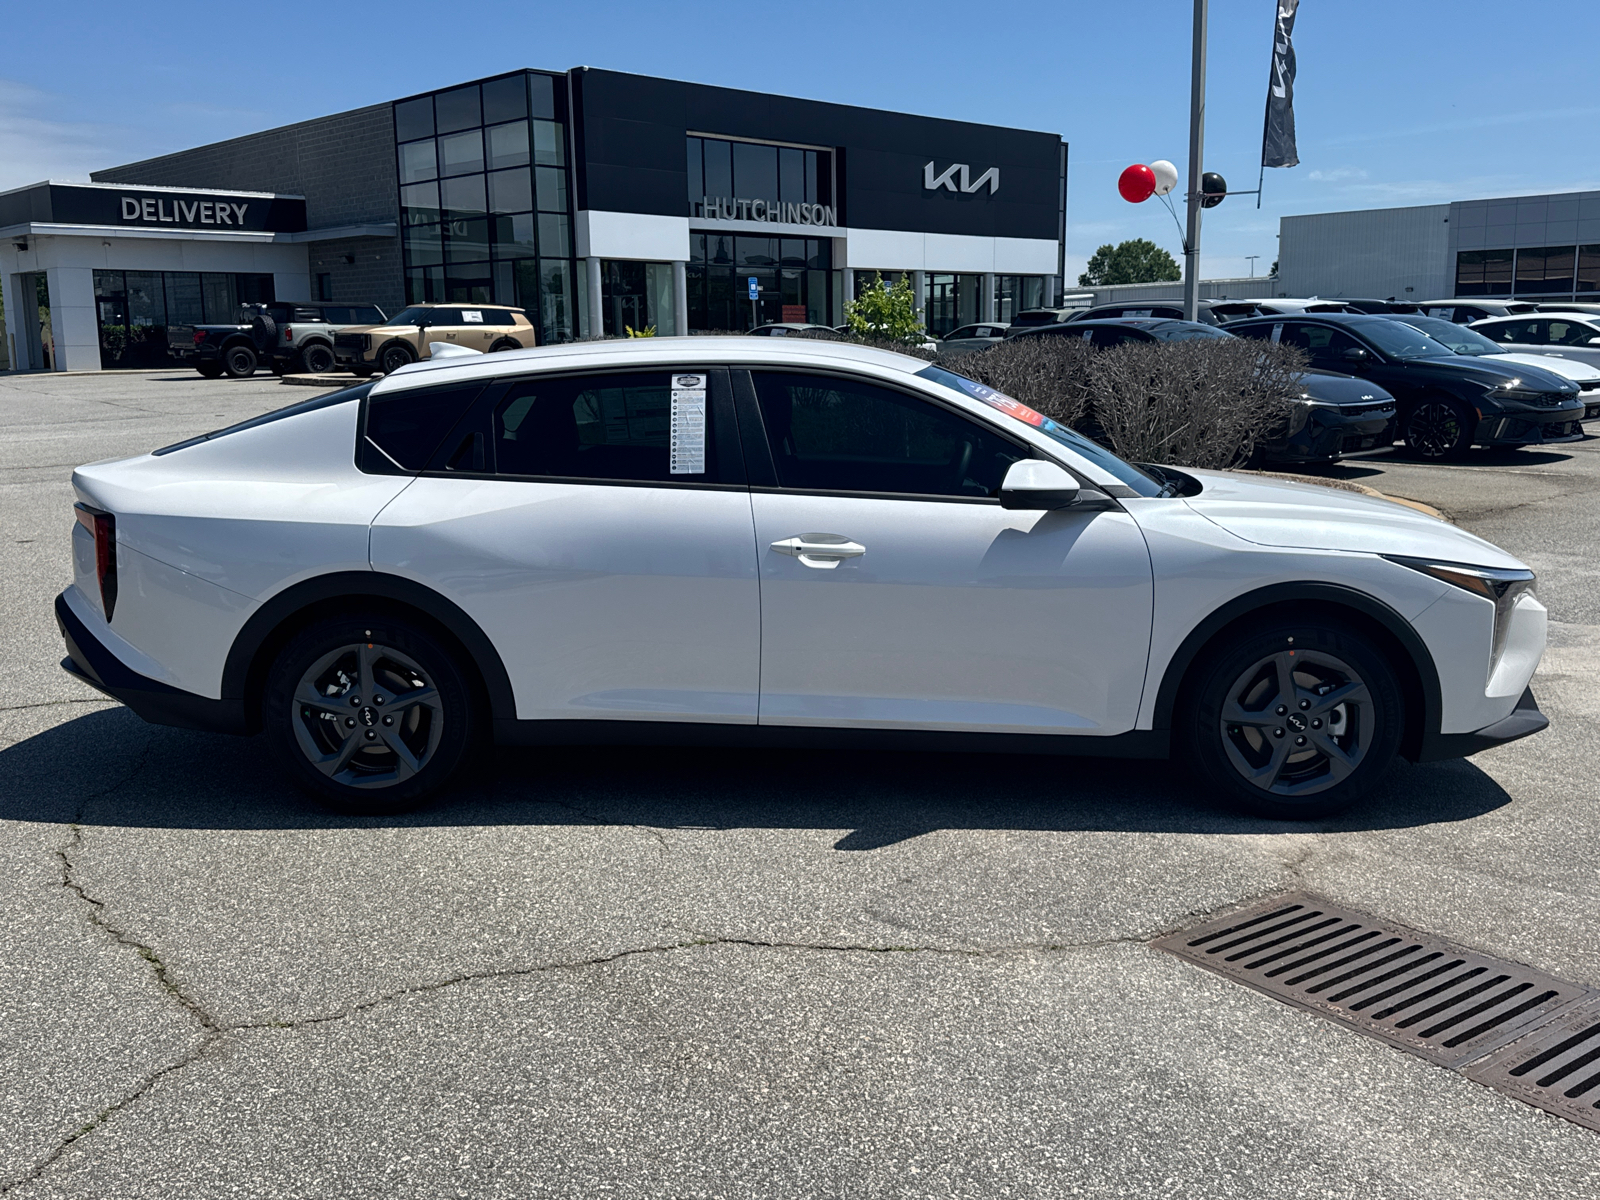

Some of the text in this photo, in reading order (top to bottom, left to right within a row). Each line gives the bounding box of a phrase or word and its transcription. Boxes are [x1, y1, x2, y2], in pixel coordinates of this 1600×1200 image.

[924, 160, 1000, 196] KIA
[121, 196, 249, 225] DELIVERY
[703, 195, 838, 228] HUTCHINSON
[364, 707, 373, 726] KIA
[444, 681, 460, 741] KUMHO
[1289, 715, 1305, 730] KIA
[1380, 680, 1394, 738] KUMHO
